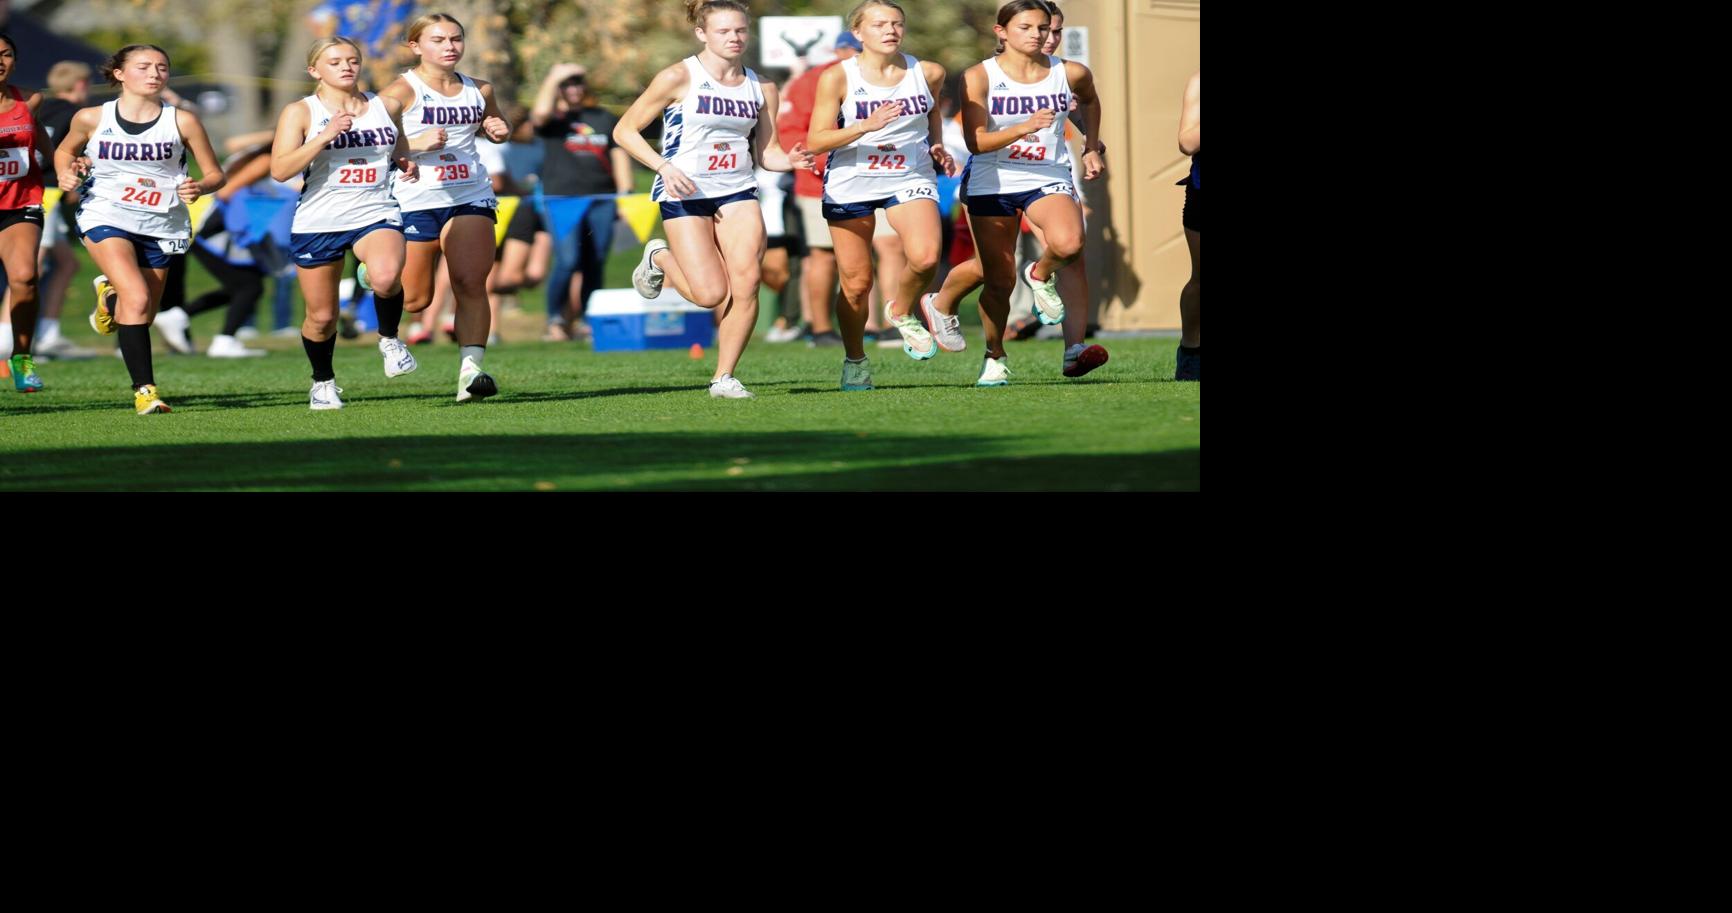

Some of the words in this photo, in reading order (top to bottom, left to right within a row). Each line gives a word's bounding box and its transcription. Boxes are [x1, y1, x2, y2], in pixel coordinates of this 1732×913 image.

[696, 95, 760, 119] NORRIS
[855, 94, 928, 120] NORIS
[991, 93, 1068, 115] NORRIS
[421, 105, 483, 125] NORRIS
[98, 141, 174, 161] NORRIS
[1008, 145, 1047, 161] 243
[708, 153, 737, 171] 241
[868, 155, 906, 170] 242
[339, 167, 377, 184] 238
[434, 164, 470, 182] 239
[121, 187, 162, 207] 240
[906, 187, 934, 198] 242
